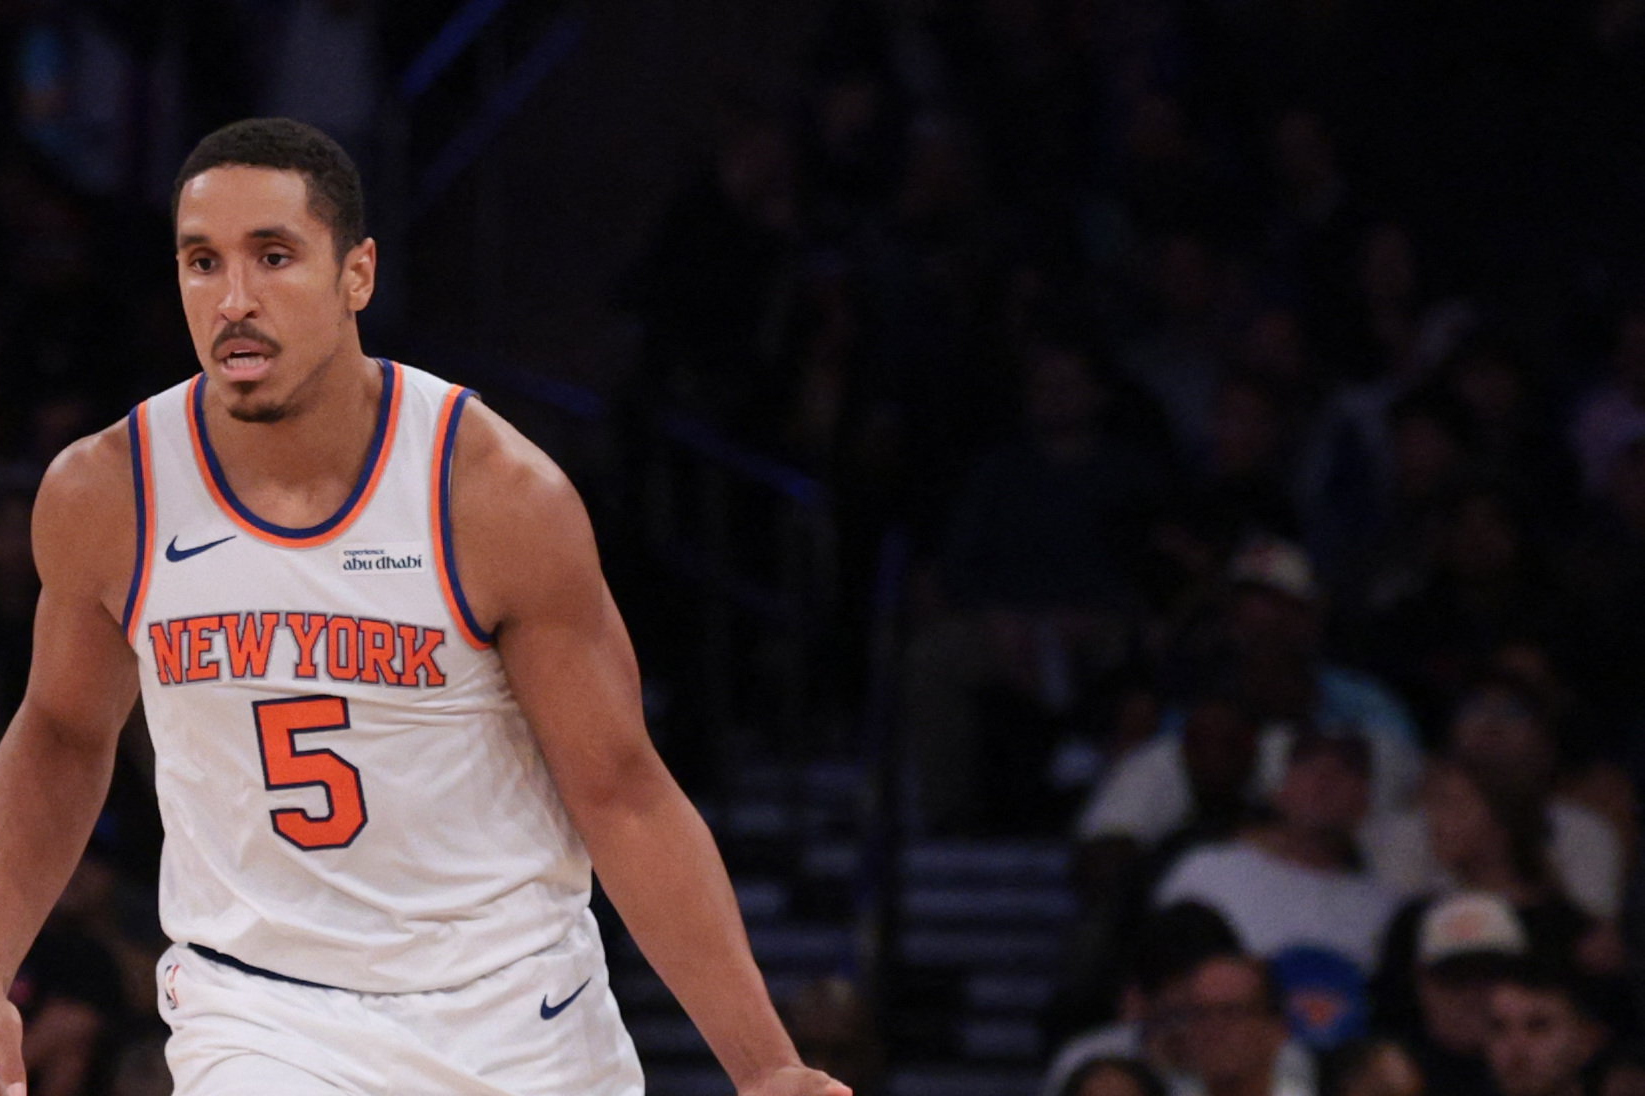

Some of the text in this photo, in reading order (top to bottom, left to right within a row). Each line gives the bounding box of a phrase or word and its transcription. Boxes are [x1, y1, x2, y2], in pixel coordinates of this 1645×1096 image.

[343, 554, 423, 571] abu dhabi
[148, 611, 447, 687] NEW YORK
[251, 694, 369, 852] 5
